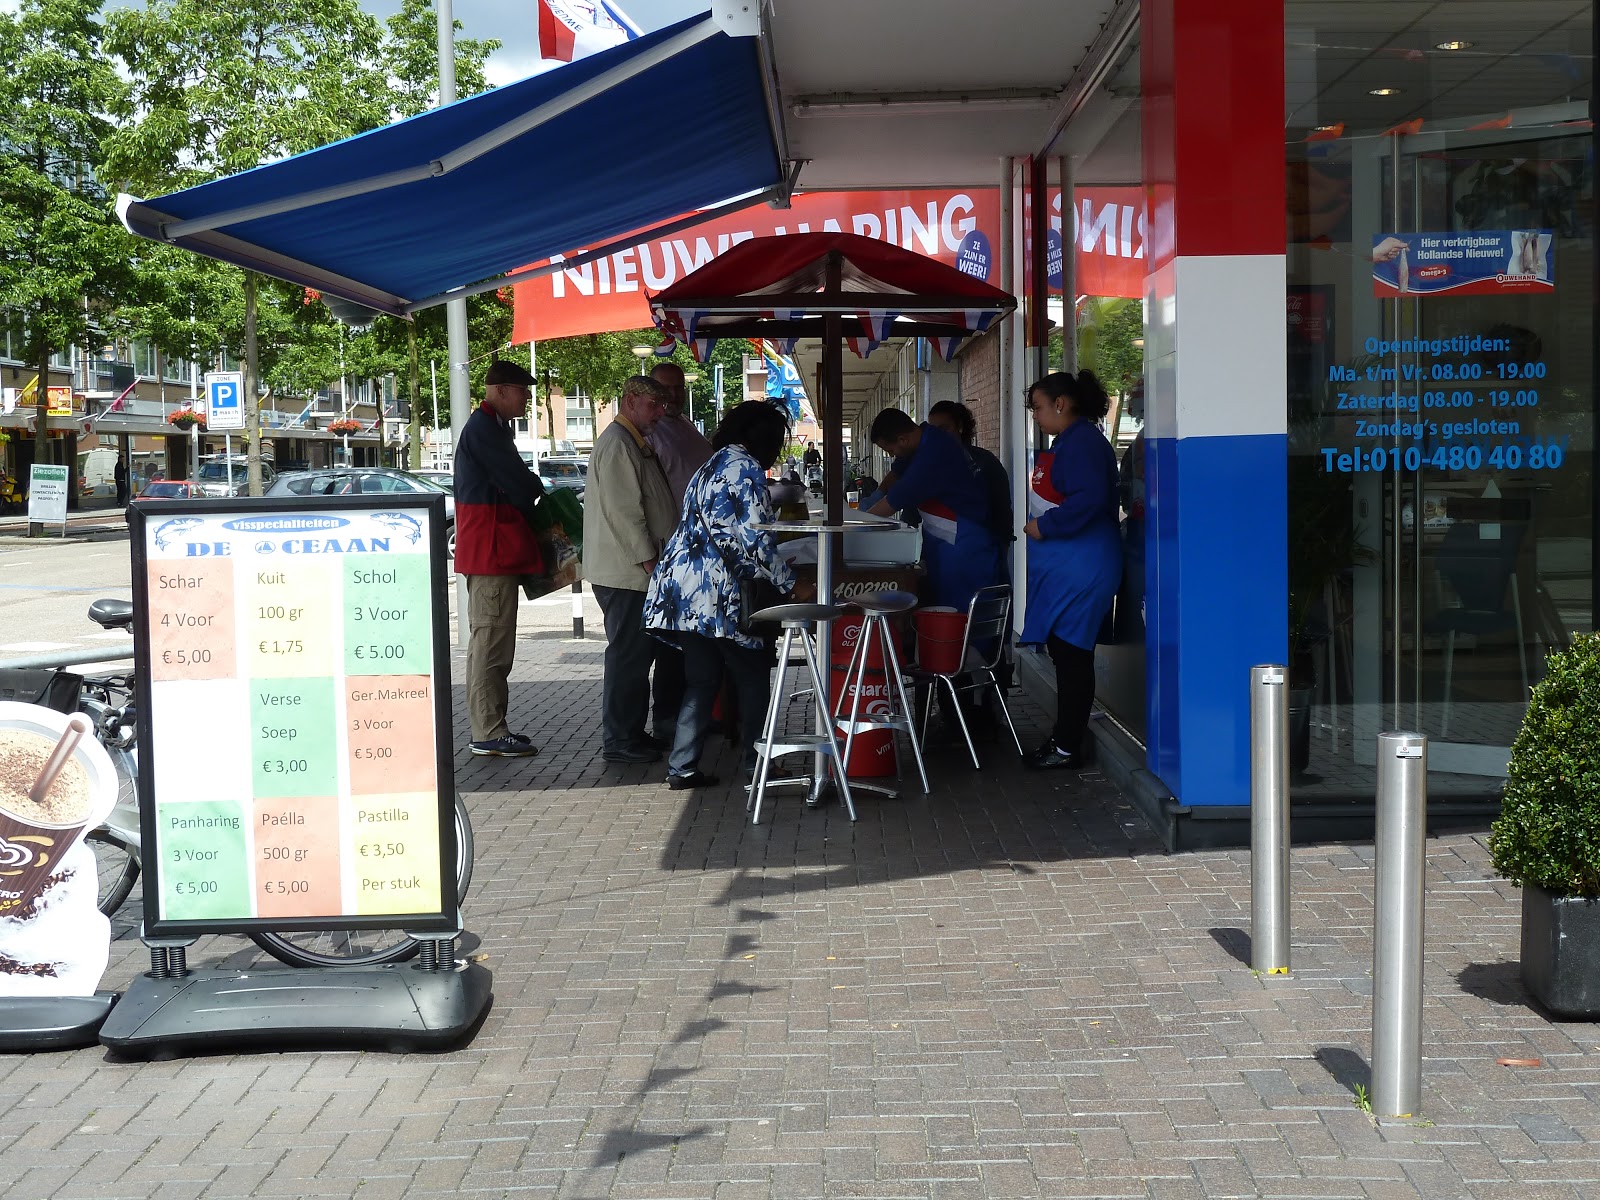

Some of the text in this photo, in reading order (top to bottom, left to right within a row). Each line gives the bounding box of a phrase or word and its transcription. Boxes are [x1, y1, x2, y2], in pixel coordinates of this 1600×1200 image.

[972, 240, 981, 250] ZE
[1421, 237, 1501, 249] Hier verkrijgbaar
[978, 254, 986, 265] ER
[1417, 248, 1504, 260] Hollandse Nieuwe!
[959, 259, 987, 280] WEER!
[1420, 268, 1447, 277] Omega-3
[1496, 274, 1537, 284] OUWEHAND
[1364, 335, 1510, 357] Openingstijden:
[1329, 365, 1362, 382] Ma.
[1366, 365, 1398, 382] t/m
[1402, 365, 1428, 381] Vr.
[1431, 363, 1481, 380] 08.00
[1497, 362, 1546, 379] 19.00
[217, 385, 232, 406] P
[1337, 392, 1419, 413] Zaterdag
[1423, 391, 1473, 408] 08.00
[1488, 390, 1538, 407] 19.00
[1355, 418, 1520, 440] Zondag's gesloten
[1321, 444, 1562, 473] Tel:010-480 40 80
[232, 518, 340, 530] visspecialiteiten
[186, 541, 232, 557] DE
[159, 574, 204, 589] Schar
[257, 571, 286, 585] Kuit
[353, 569, 396, 584] Schol
[160, 613, 214, 627] 4 Voor
[258, 606, 304, 622] 100 gr
[354, 607, 408, 621] 3 Voor
[259, 640, 303, 655] € 1,75
[354, 645, 405, 660] € 5.00
[162, 649, 212, 666] € 5,00
[260, 693, 301, 706] Verse
[351, 687, 428, 702] Ger.Makreel
[353, 718, 394, 731] 3 Voor
[261, 726, 297, 741] Soep
[354, 747, 392, 761] € 5,00
[263, 759, 308, 775] € 3,00
[171, 814, 240, 830] Panharing
[262, 812, 305, 826] Paélla
[358, 808, 409, 823] Pastilla
[173, 848, 219, 862] 3 Voor
[263, 847, 309, 863] 500 gr
[360, 842, 405, 859] € 3,50
[175, 880, 218, 896] € 5,00
[264, 880, 309, 896] € 5,00
[362, 875, 421, 891] Per stuk
